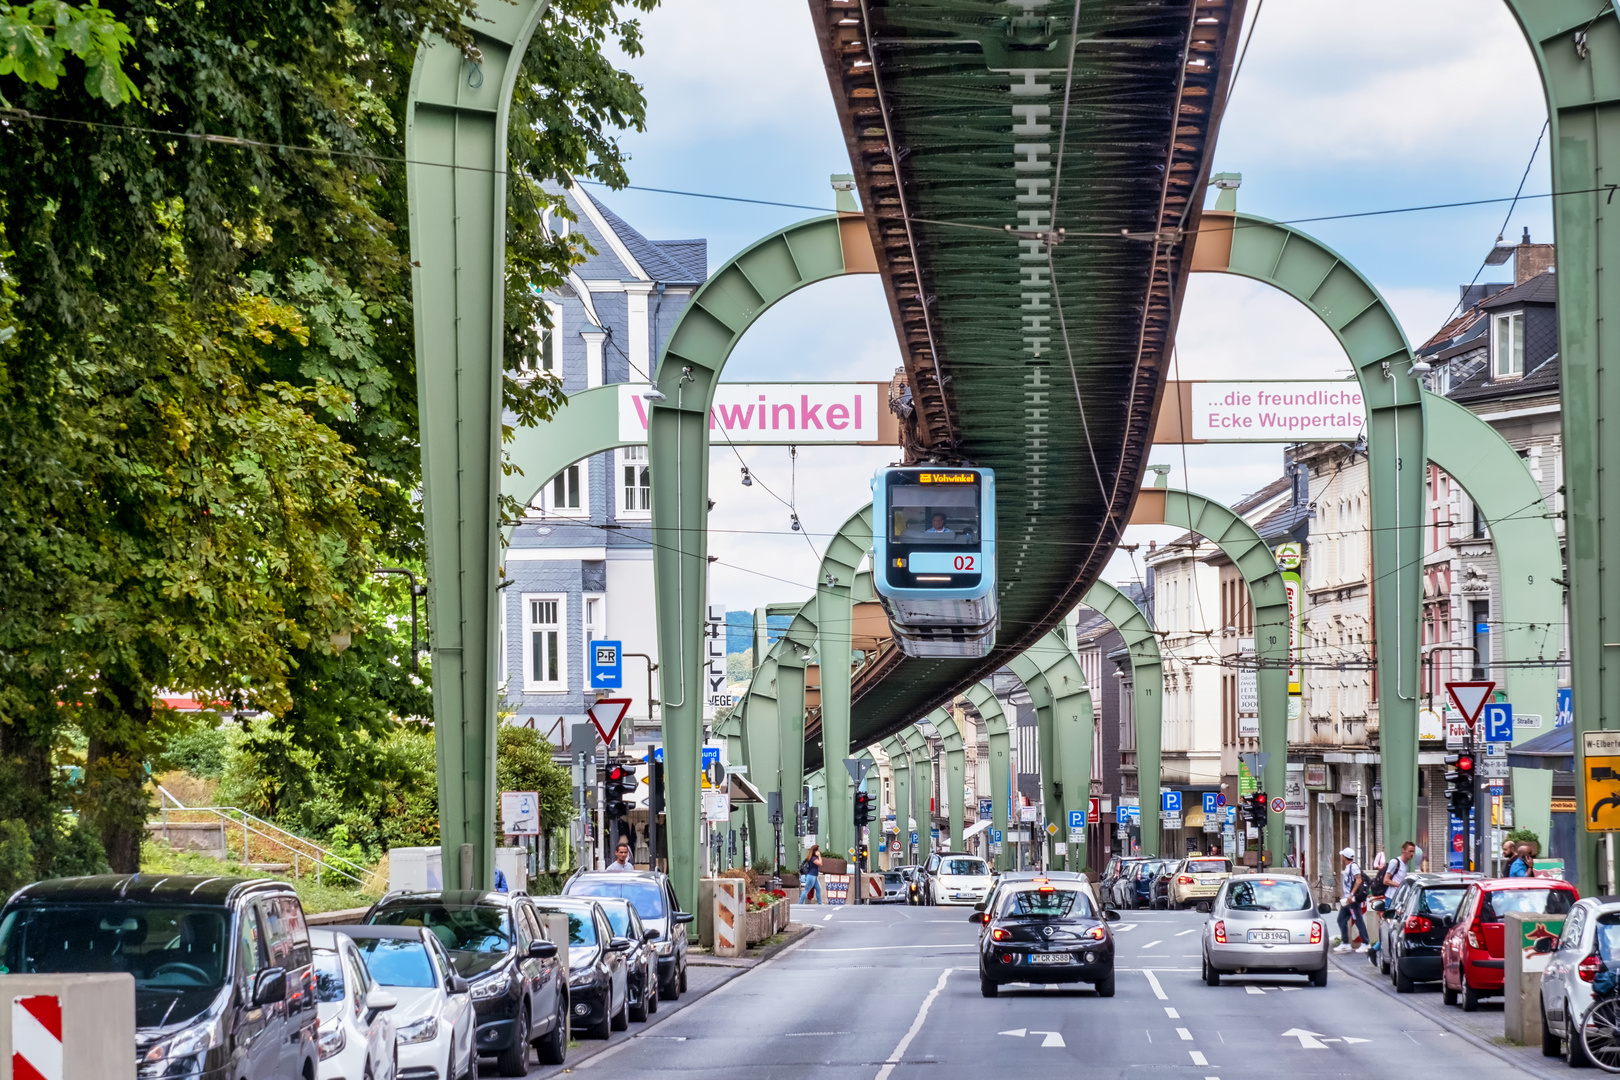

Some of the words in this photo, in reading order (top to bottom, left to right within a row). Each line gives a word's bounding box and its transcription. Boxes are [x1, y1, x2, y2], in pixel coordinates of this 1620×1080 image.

[1258, 390, 1362, 406] freundliche
[632, 394, 862, 430] Vwinkel
[1208, 413, 1252, 428] Ecke
[1258, 412, 1362, 431] Wuppertals
[933, 473, 975, 483] Vohwinkel
[953, 555, 975, 571] 02
[1527, 575, 1534, 585] 9
[1269, 635, 1277, 645] 10
[597, 651, 616, 662] P+R
[1145, 688, 1152, 696] 11
[1490, 708, 1506, 737] P
[1516, 717, 1534, 725] Straße
[1166, 793, 1177, 809] P
[1206, 795, 1215, 811] P
[1072, 812, 1081, 825] P
[1120, 808, 1127, 821] P
[995, 831, 1001, 840] P
[1271, 932, 1287, 940] 1964
